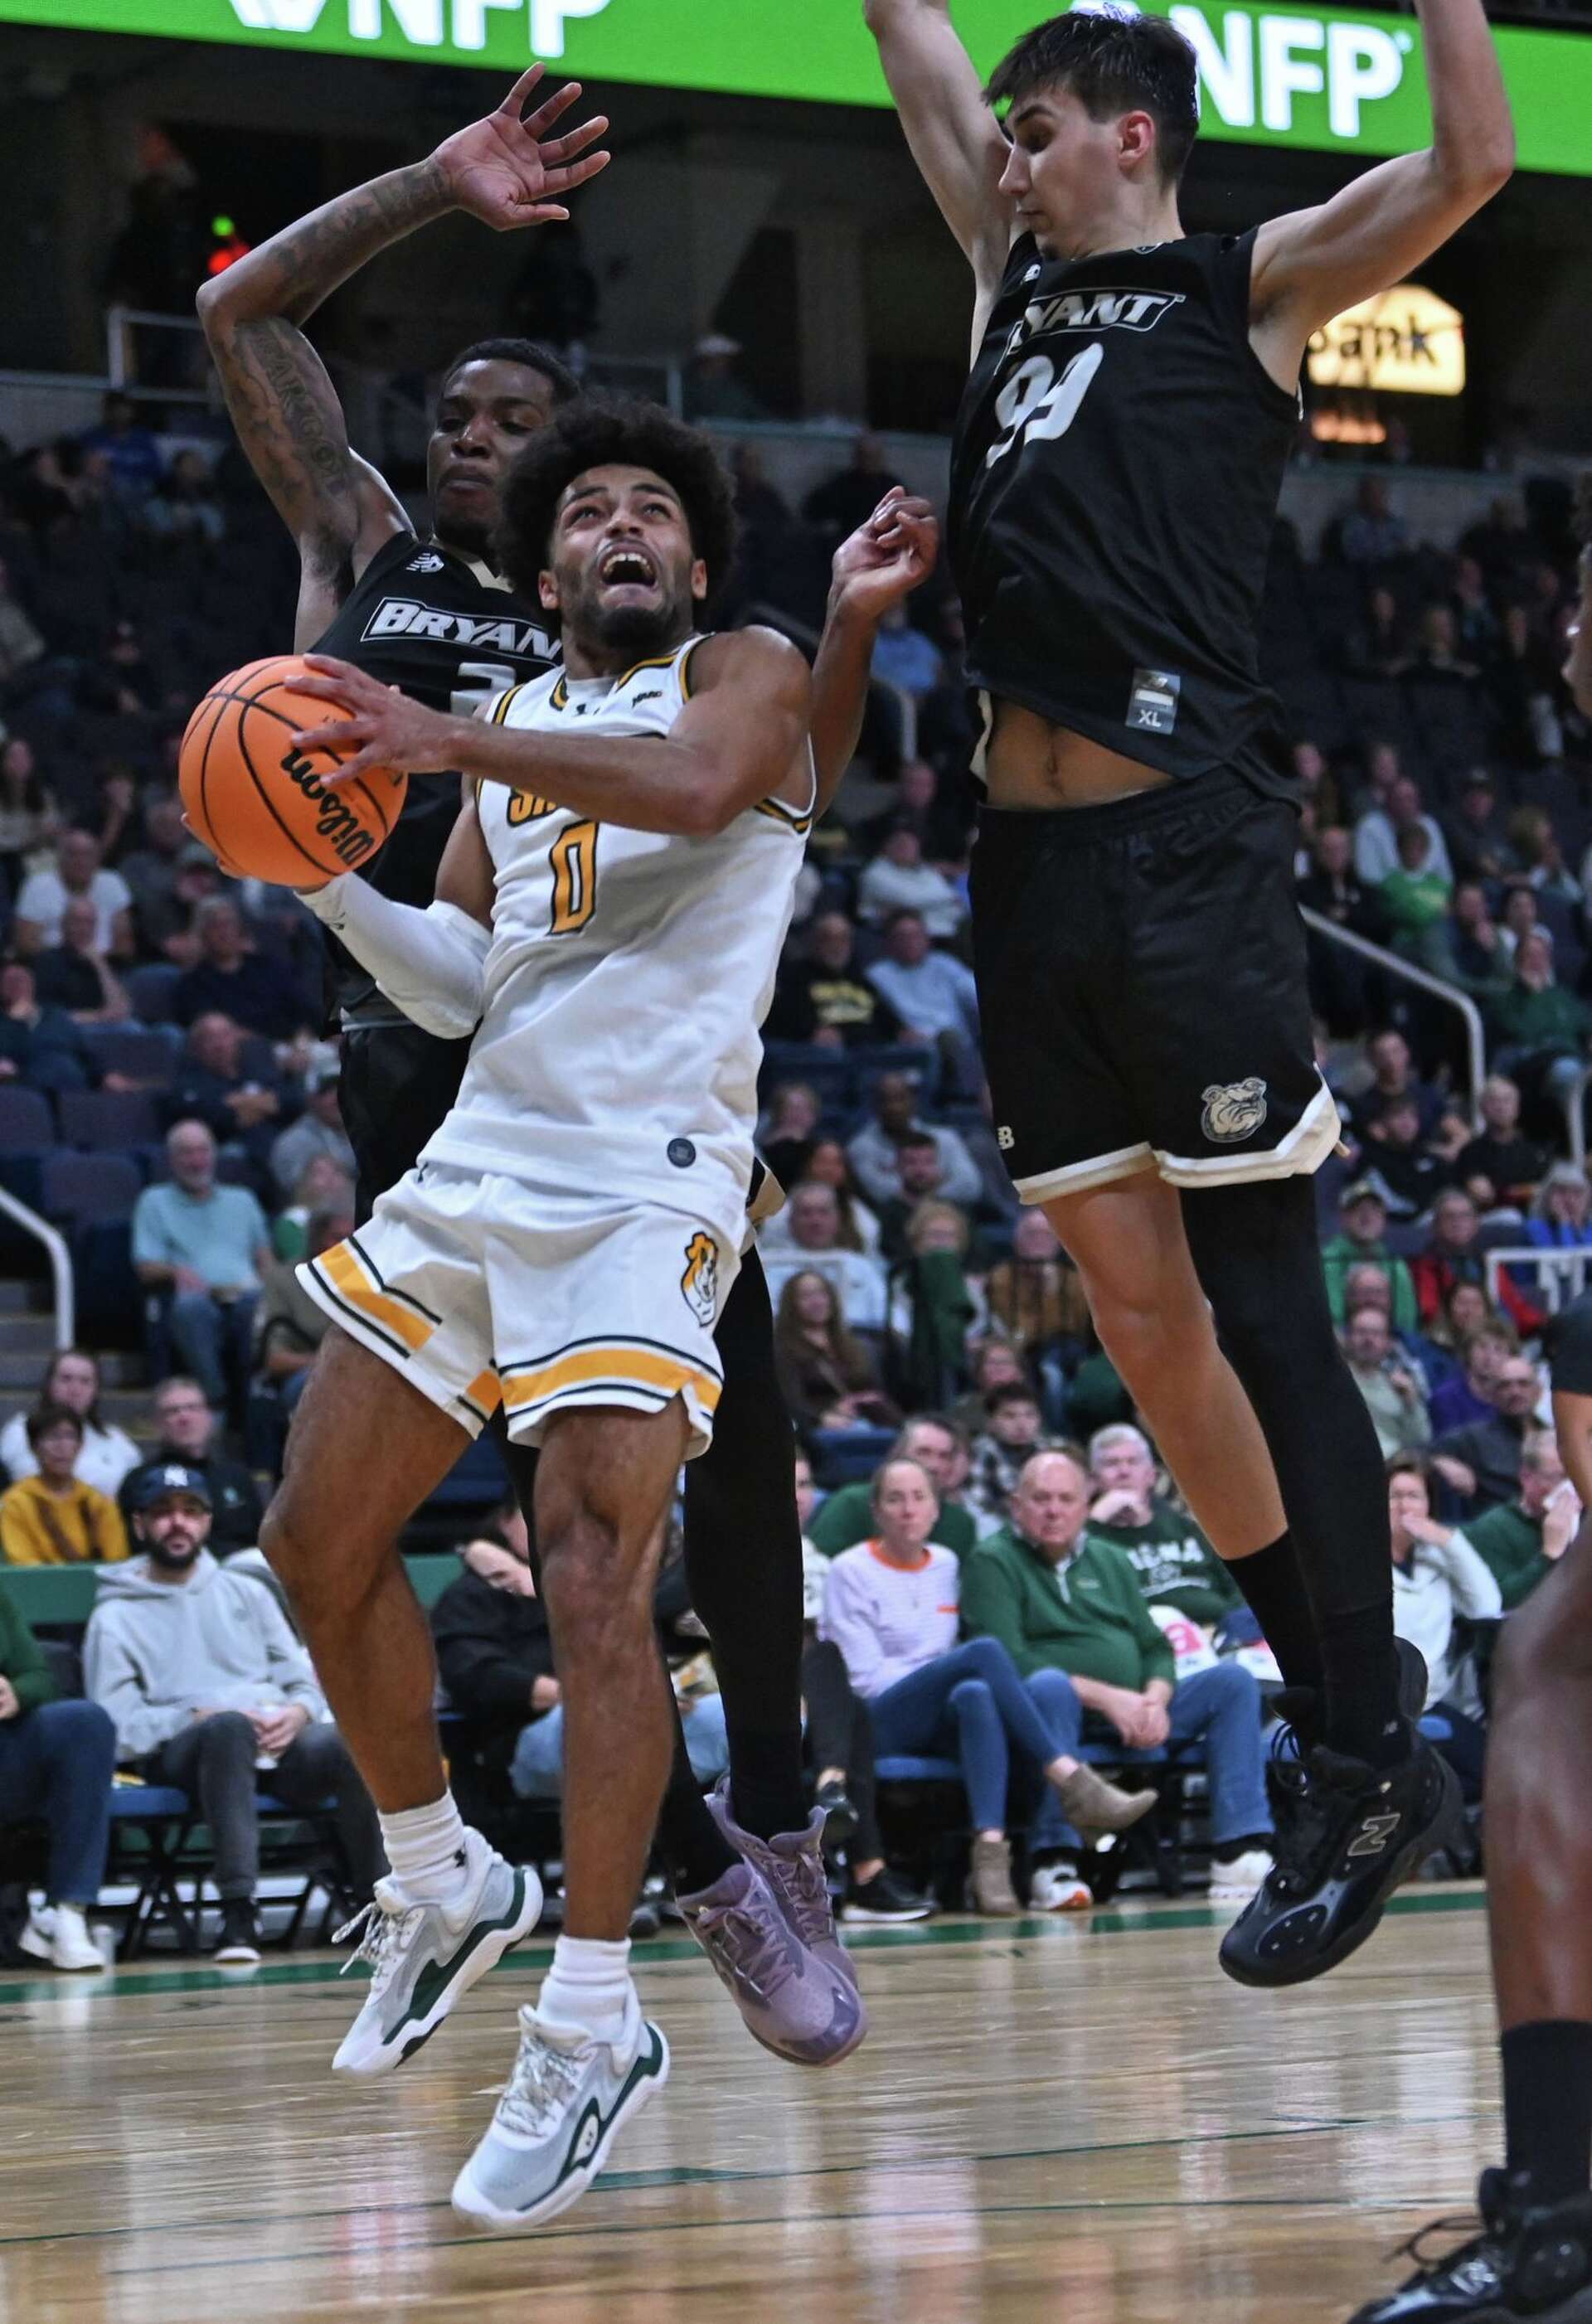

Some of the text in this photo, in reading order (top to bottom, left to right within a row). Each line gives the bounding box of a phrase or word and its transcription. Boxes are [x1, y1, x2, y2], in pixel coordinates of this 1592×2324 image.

[370, 601, 564, 661] BRYAN
[1138, 709, 1162, 727] XL
[280, 746, 375, 866] Wilson
[547, 818, 599, 936] 0
